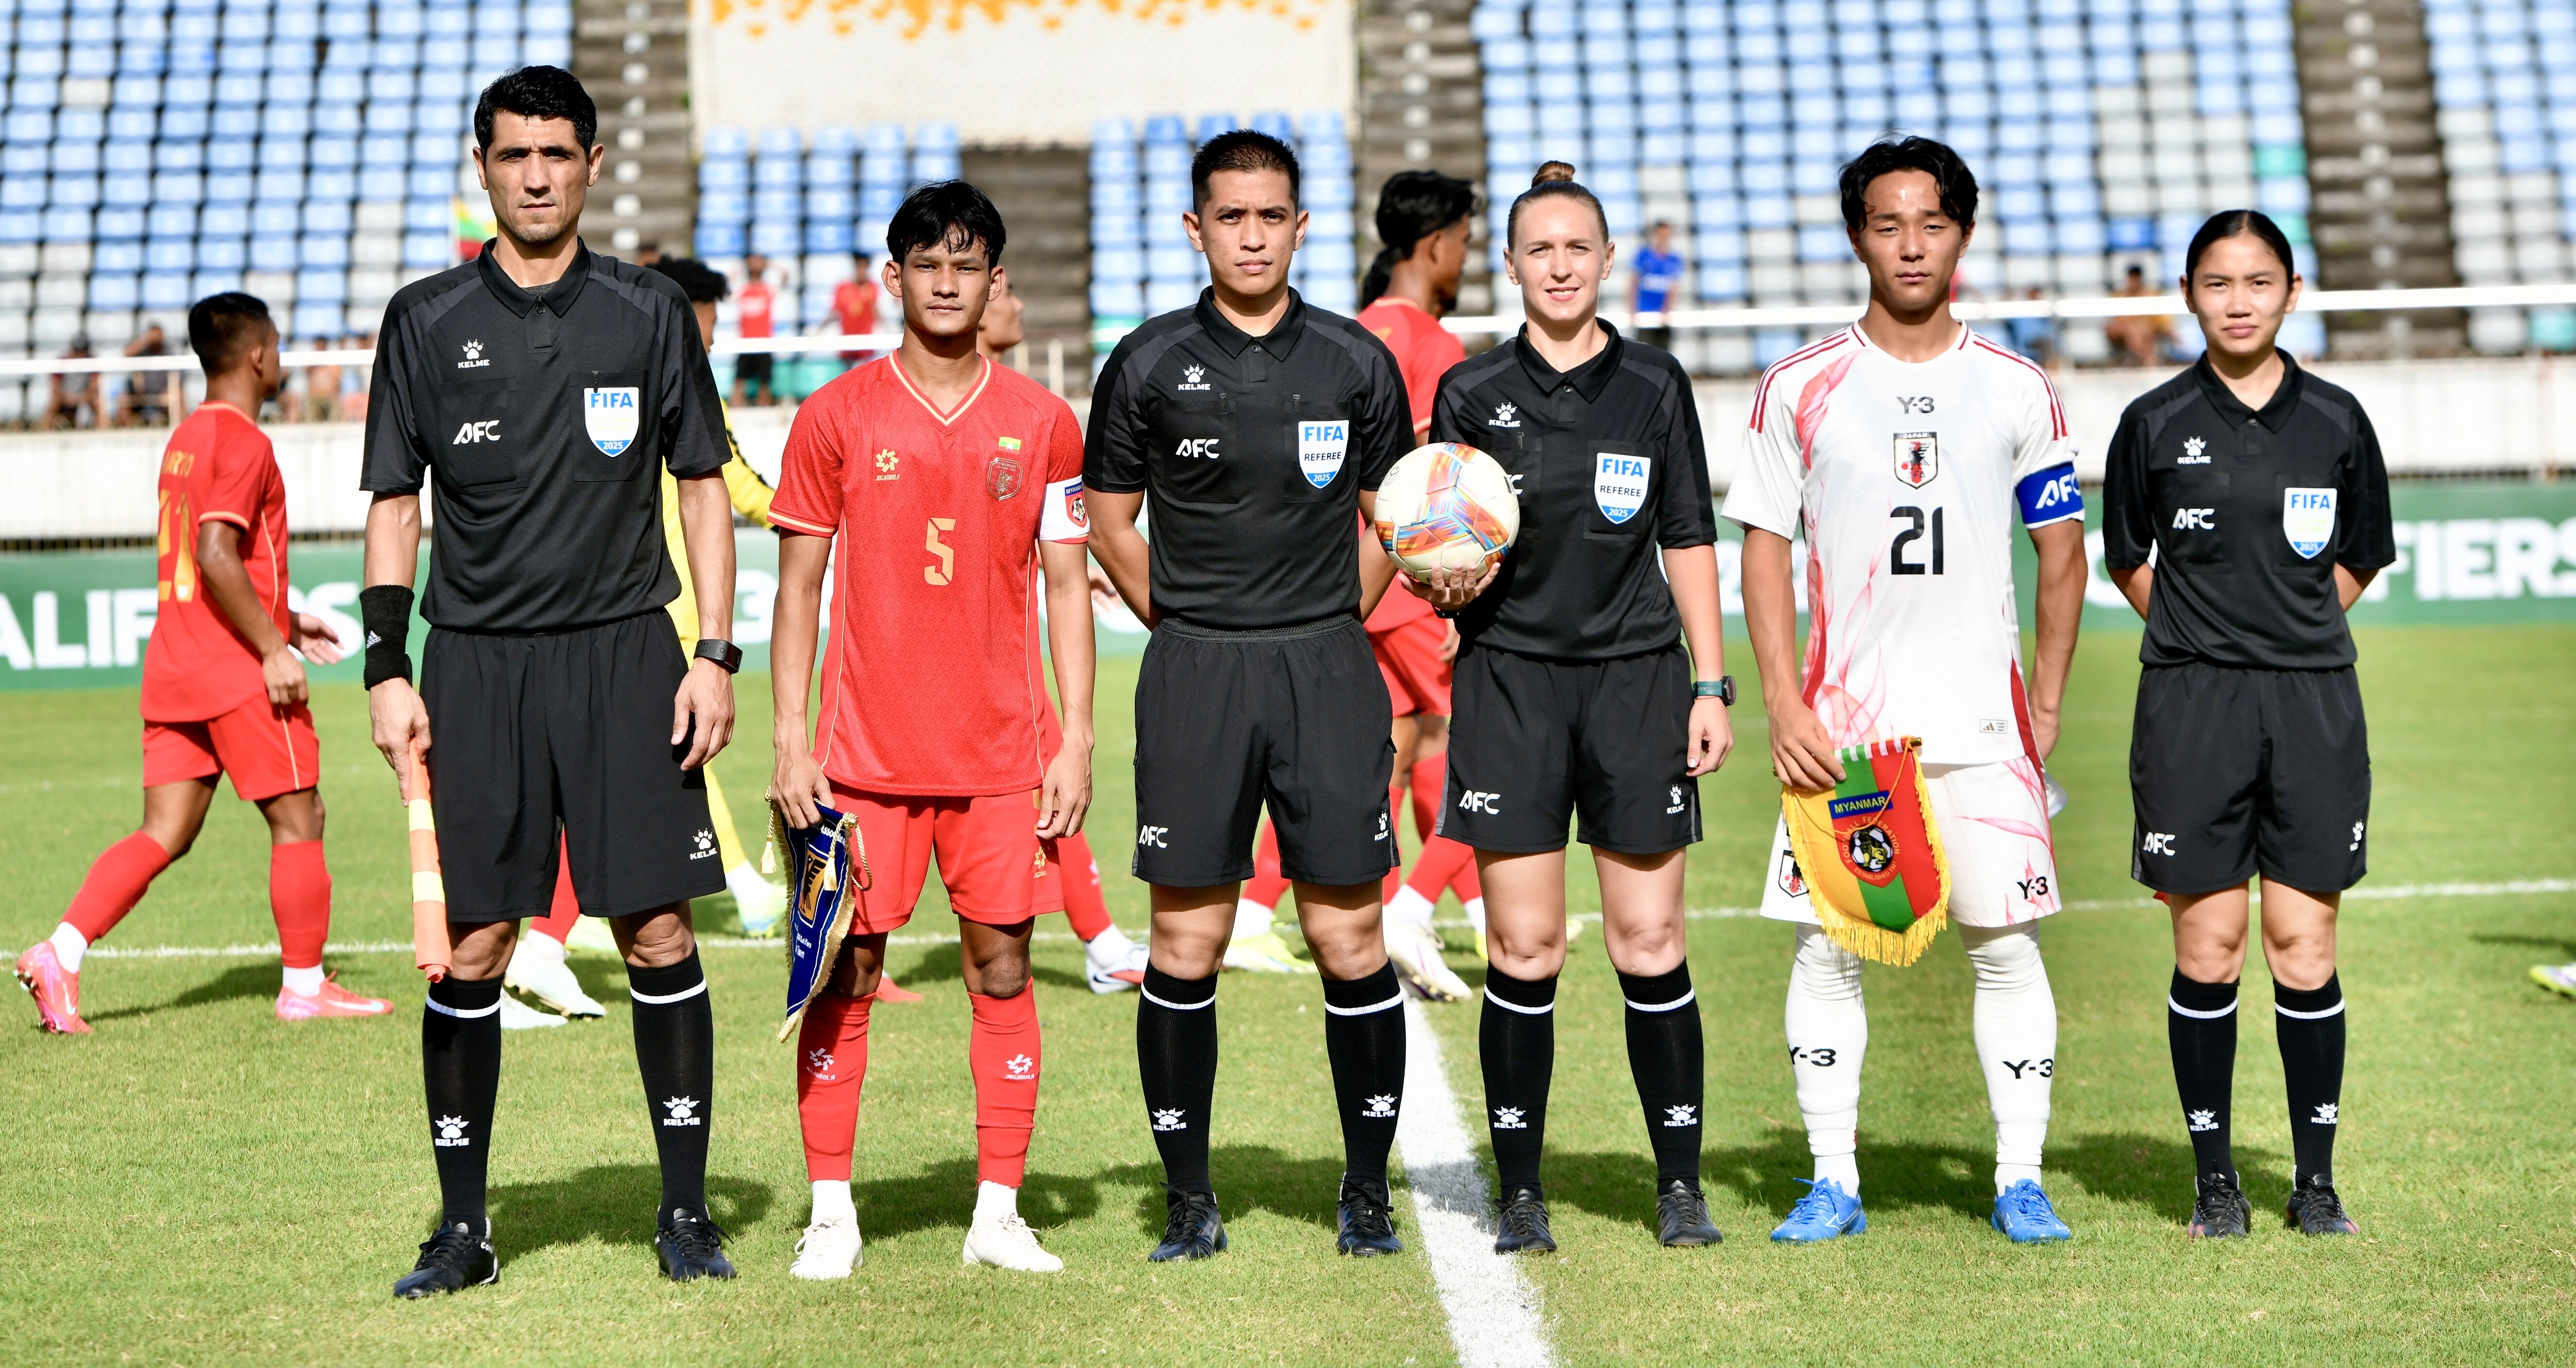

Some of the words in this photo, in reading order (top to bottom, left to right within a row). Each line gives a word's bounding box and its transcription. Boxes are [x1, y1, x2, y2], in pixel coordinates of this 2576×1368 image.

[458, 359, 490, 369] KELME
[590, 392, 634, 408] FIFA
[1896, 396, 1935, 414] Y-3
[1488, 419, 1521, 428] KELME
[453, 420, 501, 445] AFC
[1305, 426, 1344, 441] FIFA
[603, 441, 623, 450] 2025
[1175, 438, 1220, 459] AFC
[1305, 452, 1341, 461] REFEREE
[2177, 456, 2212, 465] KELME
[1602, 458, 1644, 477] FIFA
[1313, 474, 1330, 482] 2025
[1600, 485, 1642, 497] REFEREE
[2291, 494, 2331, 509] FIFA
[1608, 508, 1628, 518] 2025
[2172, 508, 2215, 530] AFC
[1890, 506, 1944, 575] 21
[924, 517, 956, 586] 5
[1458, 789, 1500, 815] AFC
[1834, 796, 1886, 814] MYANMAR
[1138, 824, 1168, 849] AFC
[1862, 816, 1901, 855] FEERATION
[2143, 831, 2176, 857] AFC
[689, 847, 718, 860] KELME
[1854, 866, 1890, 881] ESTABLISHED
[2016, 876, 2048, 899] Y-3
[1787, 1044, 1836, 1067] Y-3
[2001, 1058, 2054, 1079] Y-3
[1362, 1109, 1396, 1118] KELME
[663, 1117, 700, 1126] KELME
[1153, 1122, 1187, 1131] KELME
[1664, 1117, 1697, 1127] KELME
[2189, 1122, 2219, 1132] KELME
[435, 1138, 469, 1147] KELME
